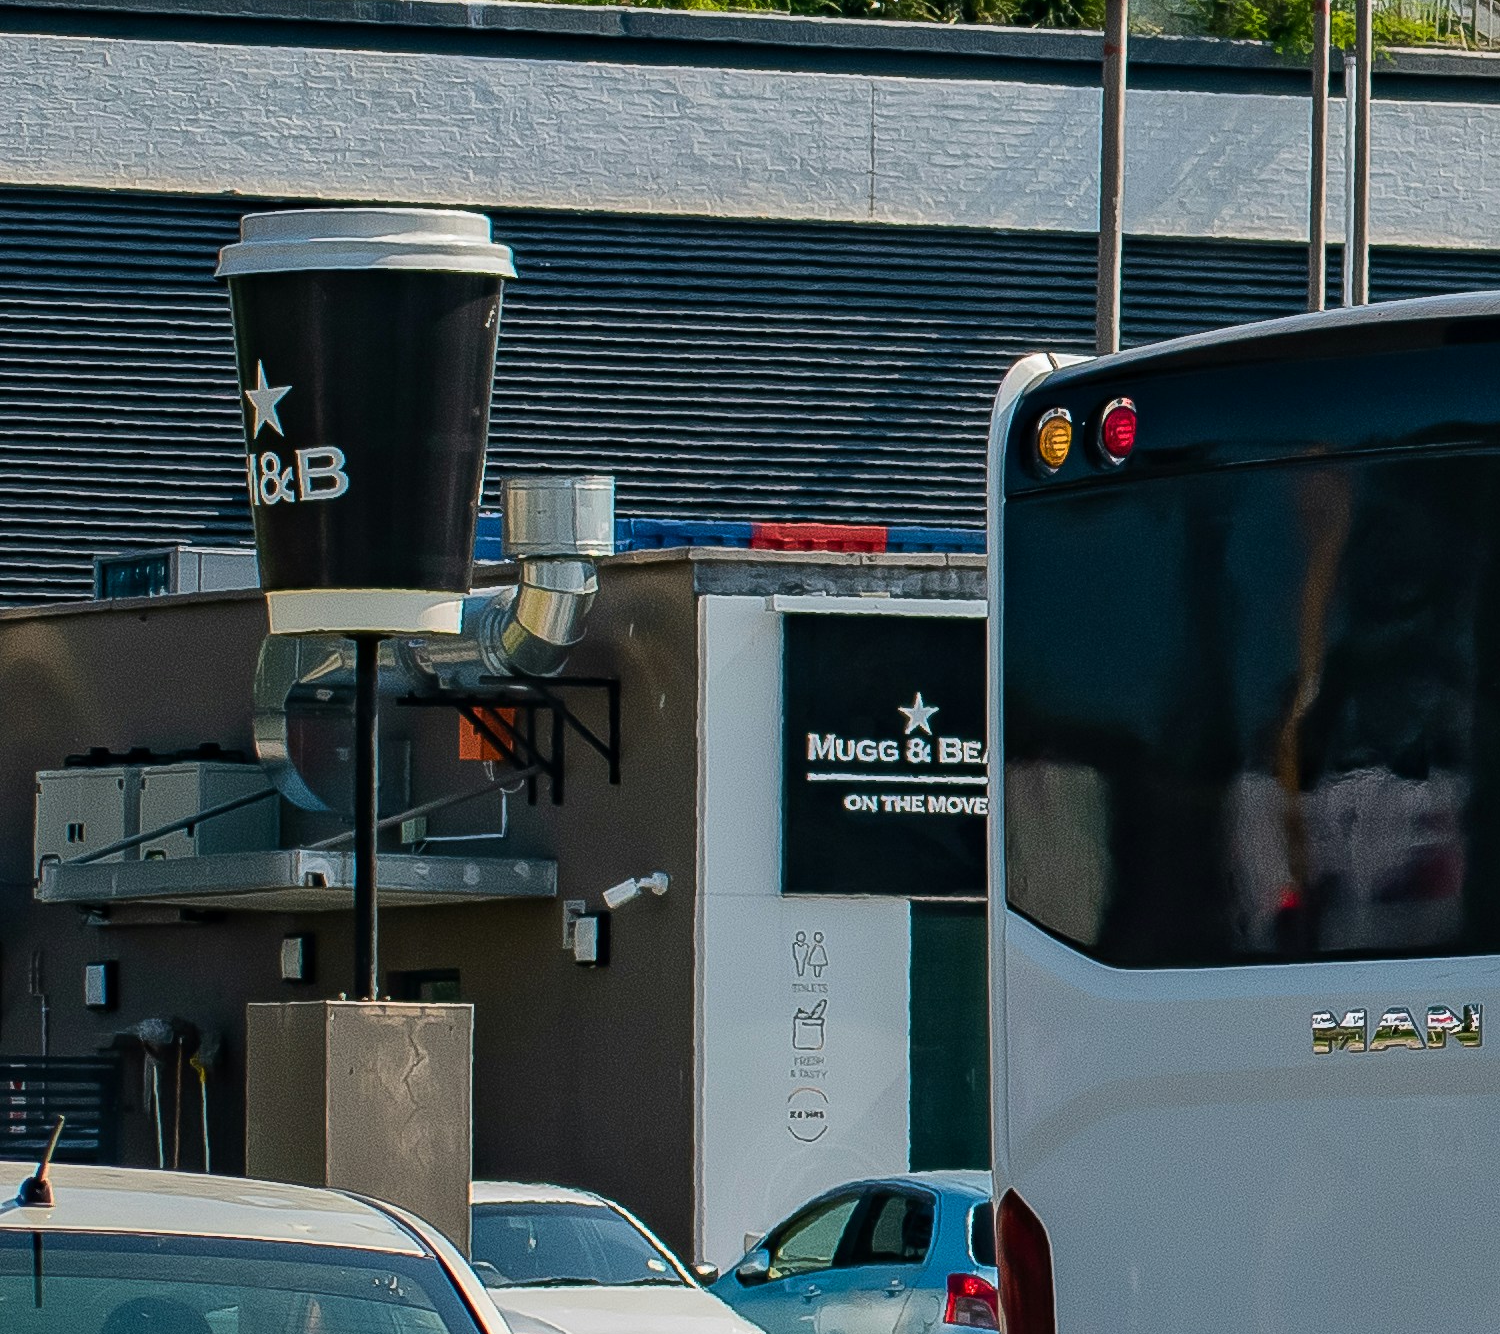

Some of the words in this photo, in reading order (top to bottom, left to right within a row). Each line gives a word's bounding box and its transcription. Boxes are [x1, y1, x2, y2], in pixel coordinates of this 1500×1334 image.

[905, 738, 932, 764] &
[844, 793, 878, 813] ON
[881, 794, 925, 814] THE
[927, 795, 989, 815] MOVE
[1311, 1003, 1484, 1054] MAN
